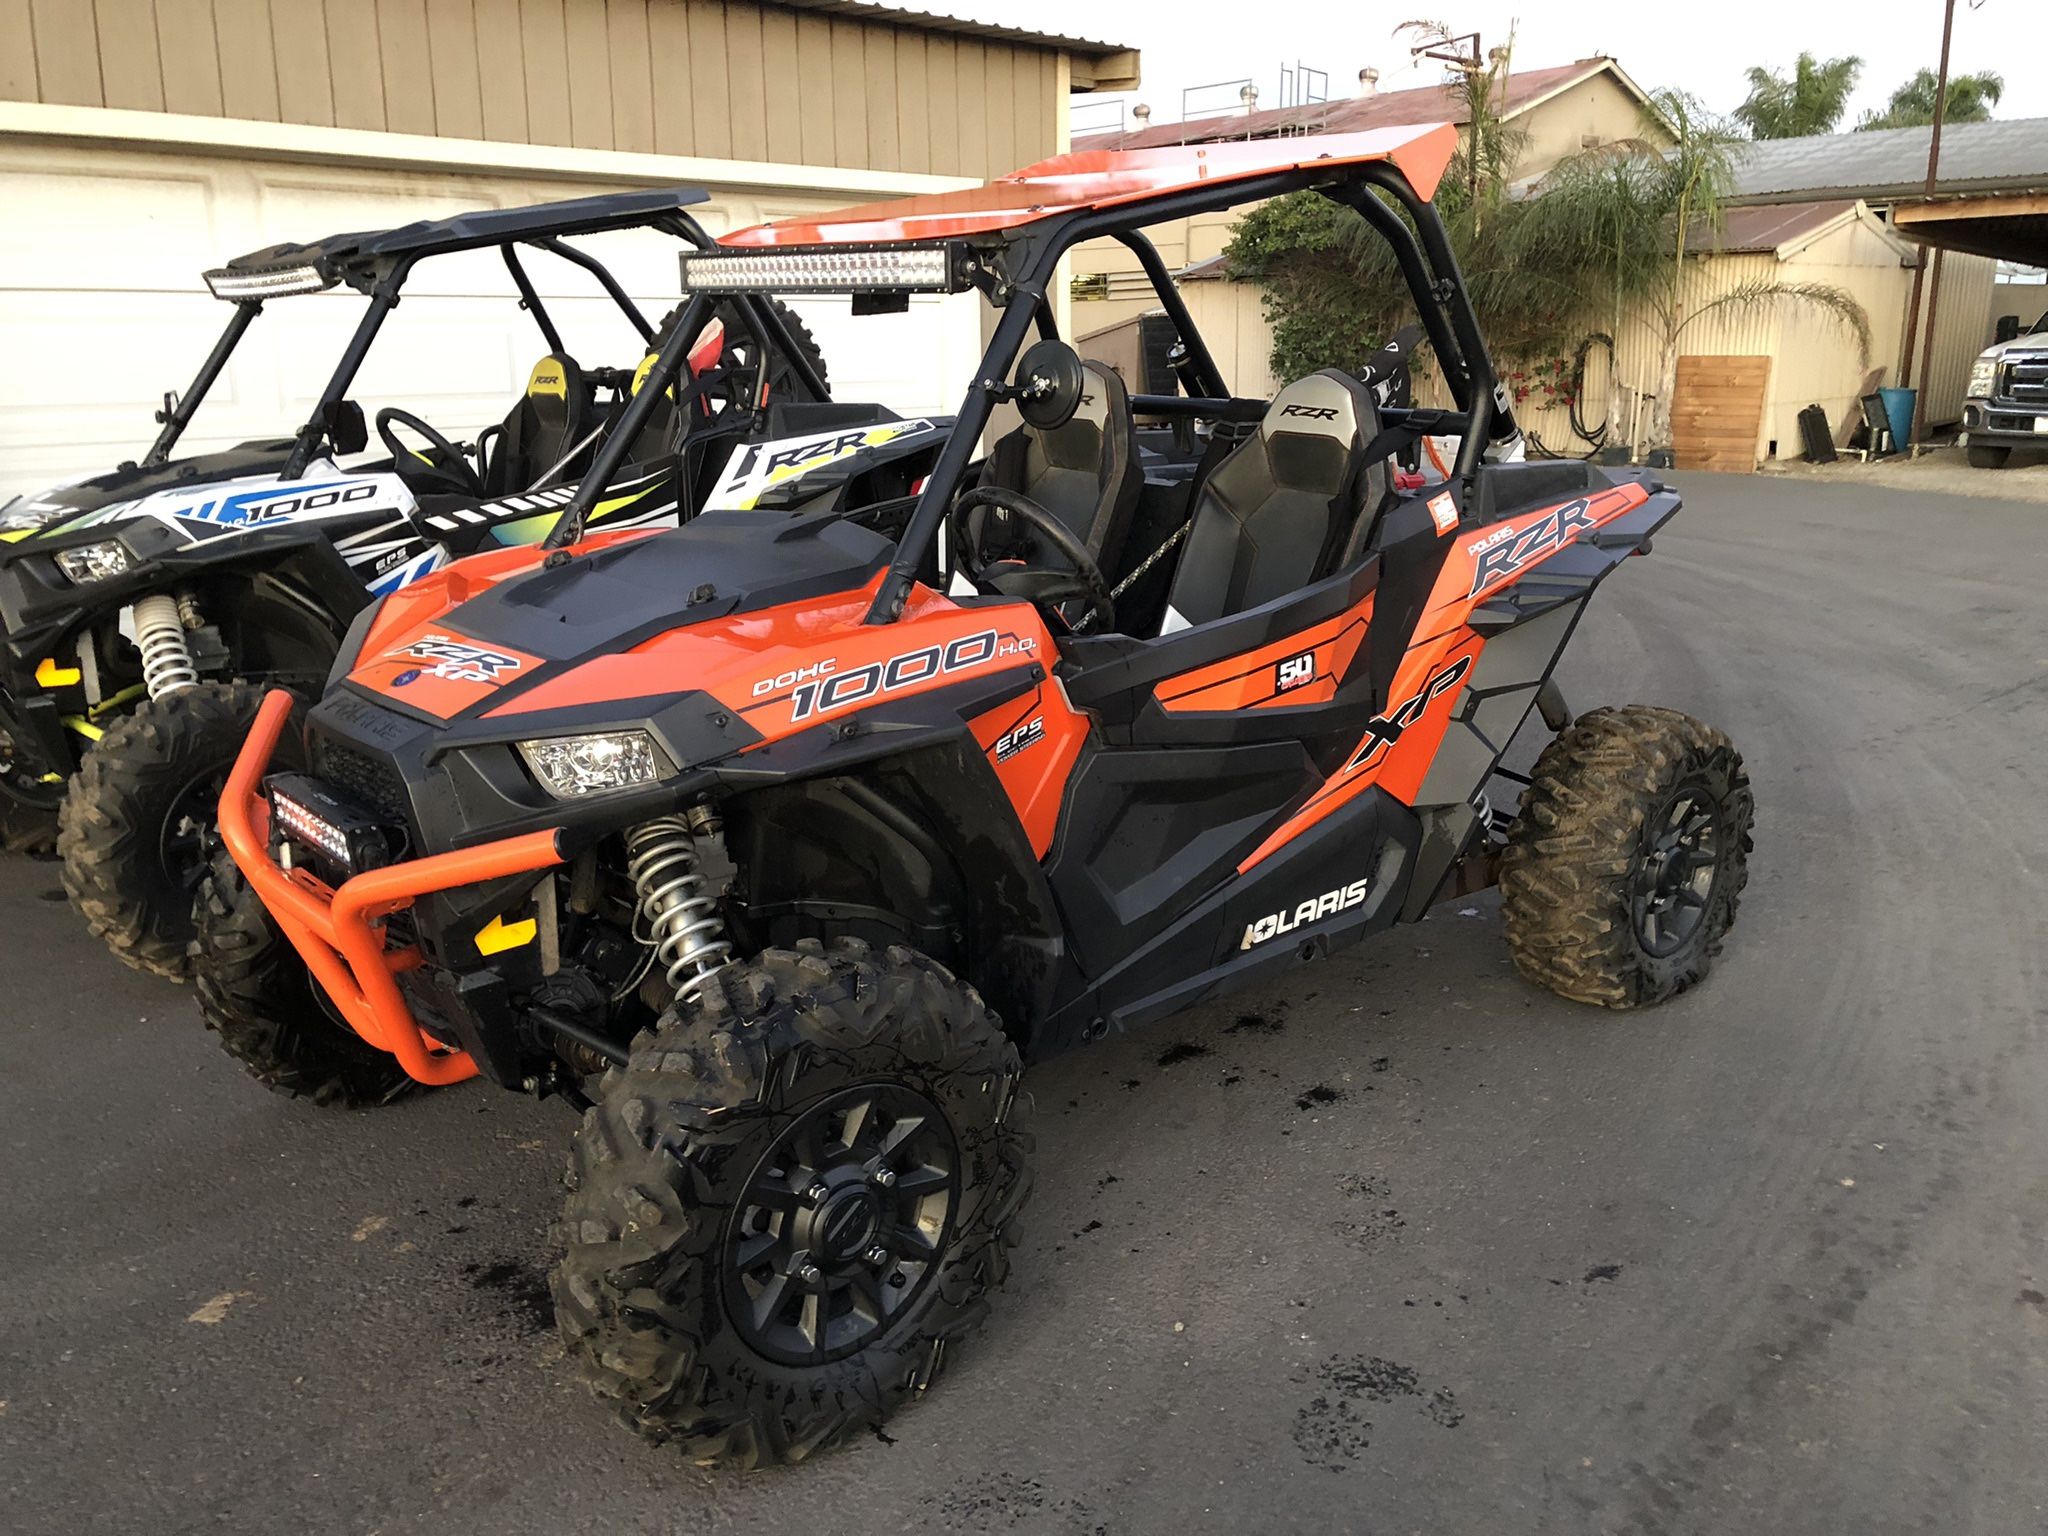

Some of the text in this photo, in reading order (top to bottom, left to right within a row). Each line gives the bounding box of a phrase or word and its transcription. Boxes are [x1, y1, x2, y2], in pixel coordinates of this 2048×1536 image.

[534, 376, 559, 385] RZR
[1279, 404, 1340, 421] RZR
[765, 432, 868, 475] RZR
[248, 484, 378, 522] 1000
[375, 546, 406, 571] EPS
[1467, 525, 1515, 557] POLARIS
[1467, 498, 1597, 600] RZR
[383, 640, 521, 677] RZR
[421, 663, 490, 682] XP
[752, 657, 838, 697] DOHC
[789, 628, 999, 724] 1000
[1344, 654, 1472, 775] XP
[995, 715, 1044, 754] EPS
